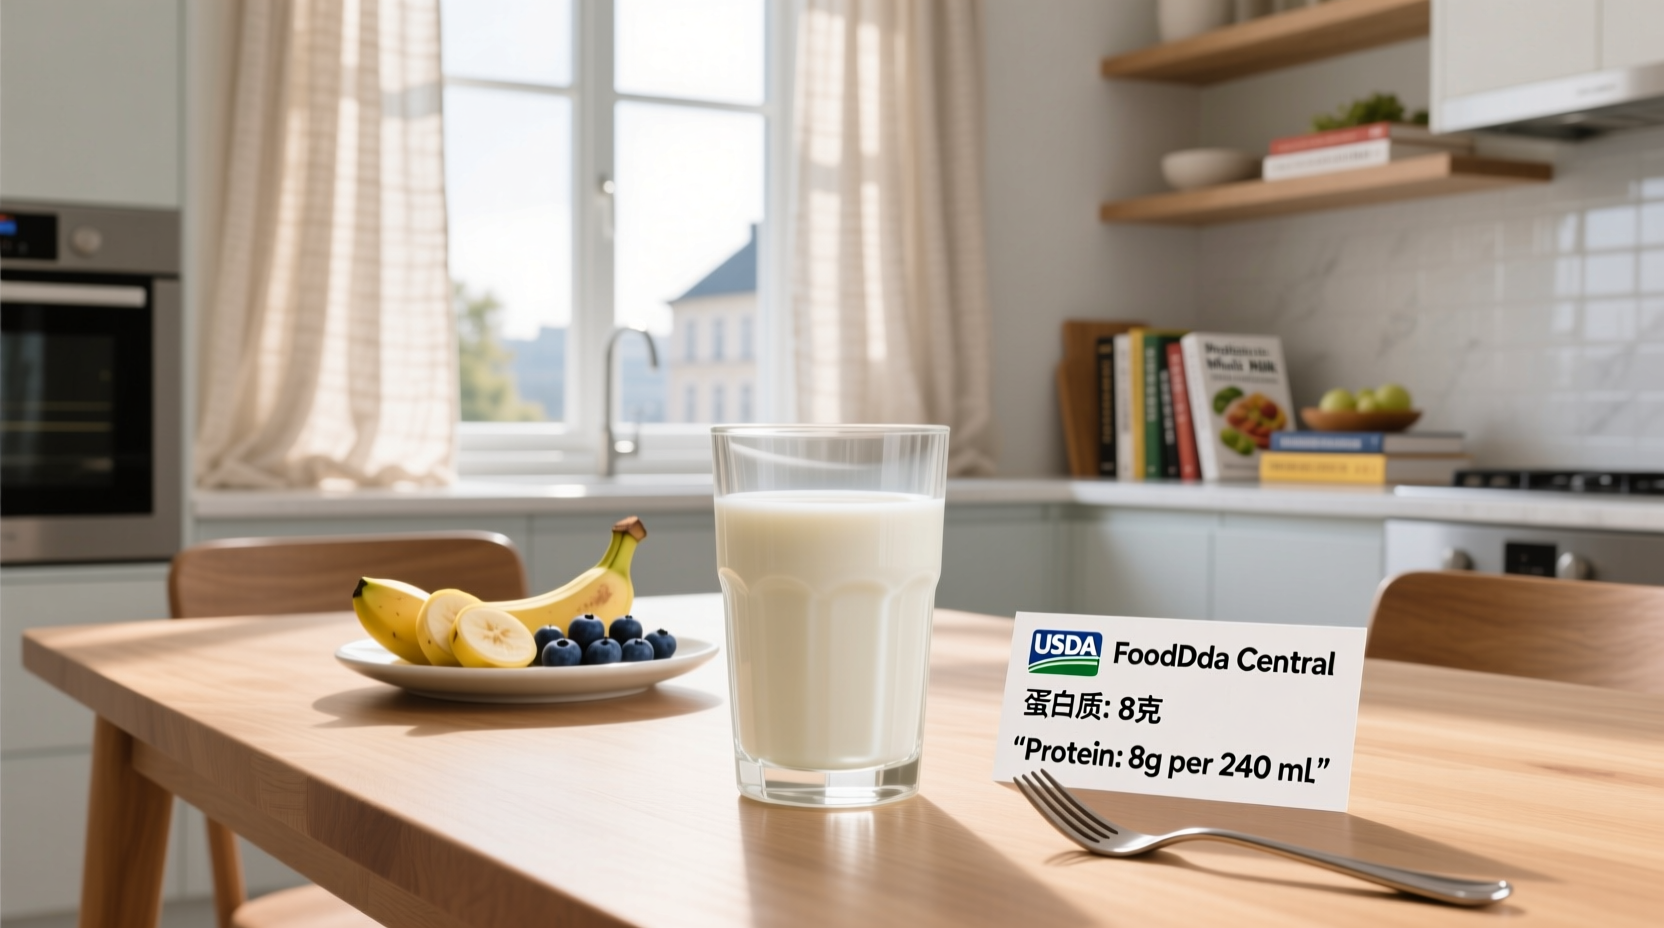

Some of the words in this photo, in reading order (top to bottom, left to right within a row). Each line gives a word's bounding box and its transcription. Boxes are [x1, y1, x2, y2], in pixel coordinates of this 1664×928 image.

[1034, 633, 1097, 656] USDA
[1113, 641, 1230, 671] FoodDda
[1236, 646, 1336, 676] Central
[1023, 688, 1111, 721] 蛋白质:
[1118, 694, 1164, 725] 8克
[1127, 744, 1163, 778] 8g
[1167, 754, 1215, 780] per
[1218, 751, 1272, 780] 240
